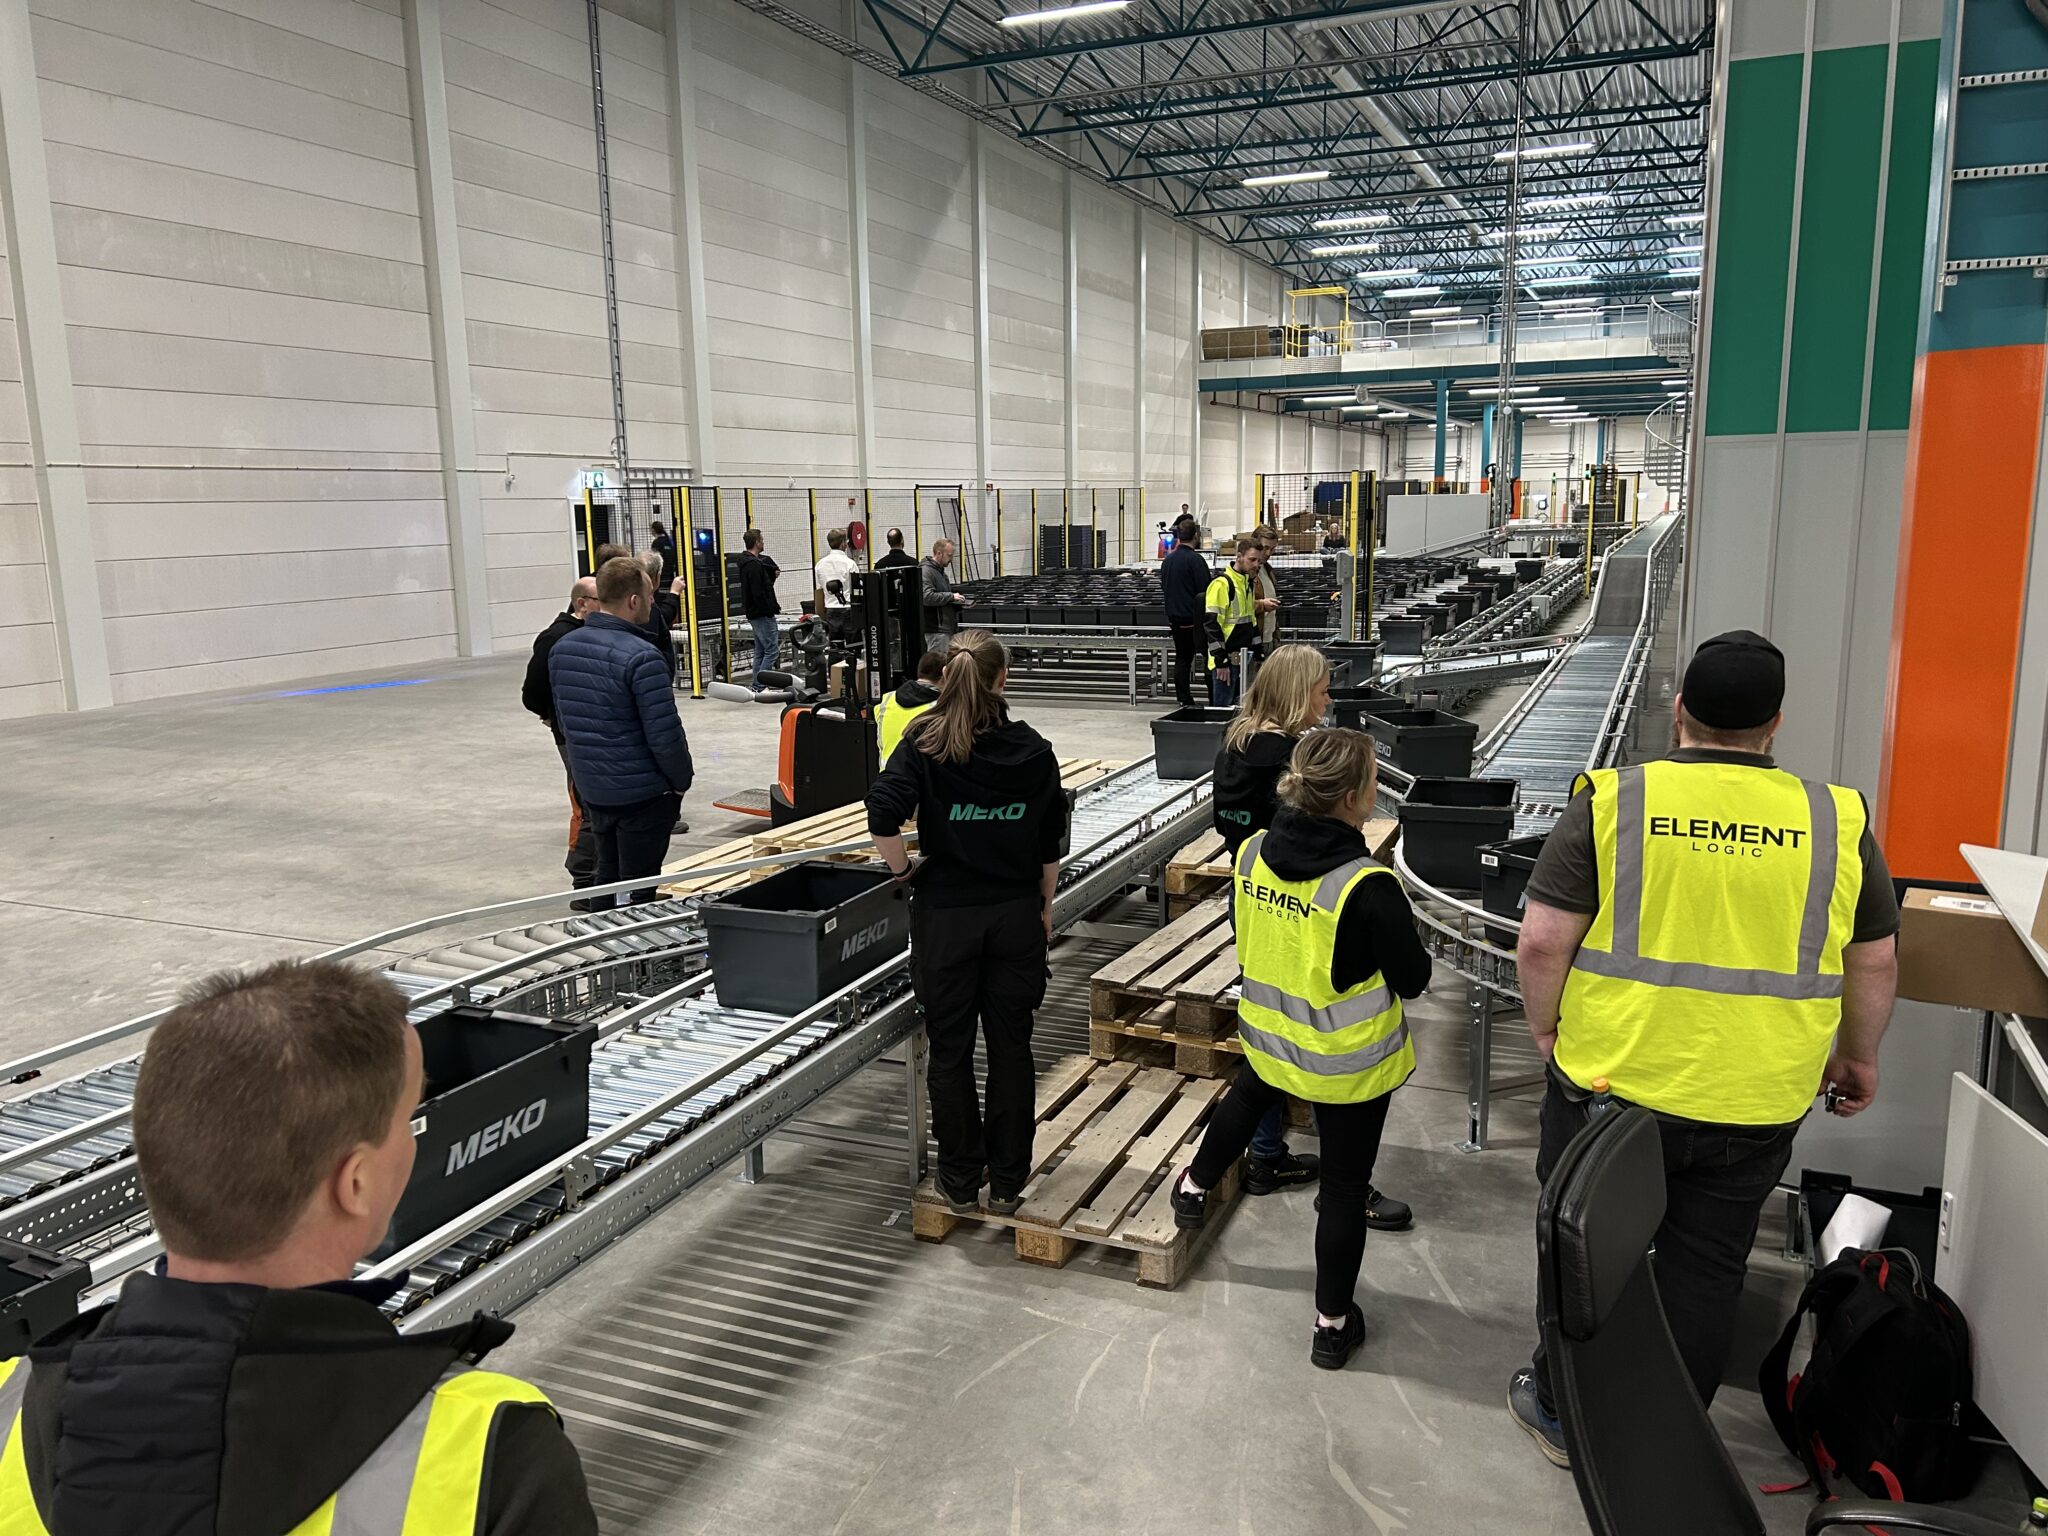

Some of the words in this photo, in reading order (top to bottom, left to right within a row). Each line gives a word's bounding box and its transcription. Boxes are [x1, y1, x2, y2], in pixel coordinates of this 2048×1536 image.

[870, 625, 878, 654] staxio
[872, 656, 879, 667] BT
[949, 803, 1027, 821] MEKO
[1650, 816, 1807, 849] ELEMENT
[1692, 841, 1763, 858] LOGIC
[1257, 902, 1300, 924] LOGIC
[841, 917, 889, 962] MEKO
[444, 1098, 547, 1177] MEKO
